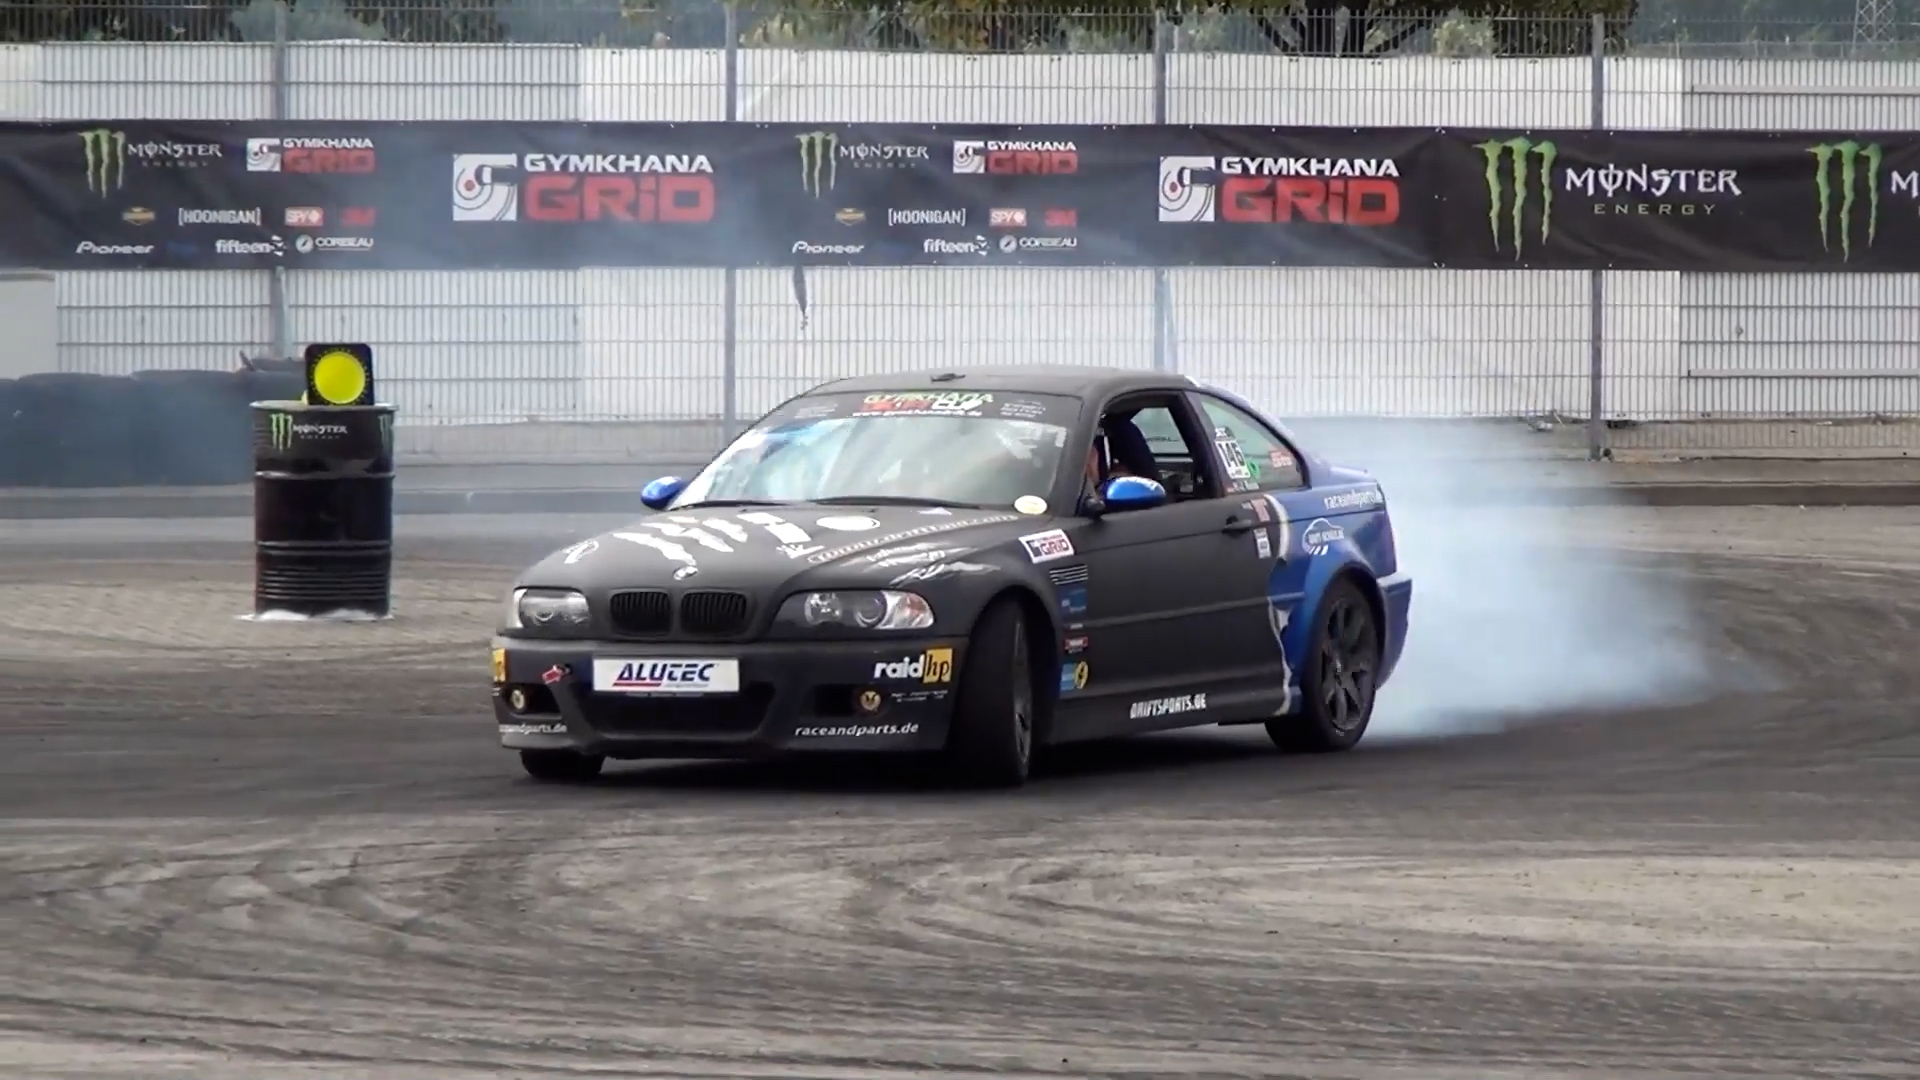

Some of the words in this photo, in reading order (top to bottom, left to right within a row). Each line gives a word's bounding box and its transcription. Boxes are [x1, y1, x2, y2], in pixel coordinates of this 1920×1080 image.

[128, 140, 223, 158] MONSTER
[283, 138, 374, 149] GYMKHANA
[840, 143, 930, 160] MONSTER
[987, 140, 1077, 151] GYMKHANA
[524, 153, 714, 173] GYMKHANA
[1221, 156, 1399, 177] GYMKHANA
[1565, 163, 1742, 197] MONSTER
[1594, 203, 1716, 216] ENERGY
[616, 663, 715, 682] ALUTEC
[873, 654, 925, 679] raid
[795, 722, 919, 737] raceandparts.de
